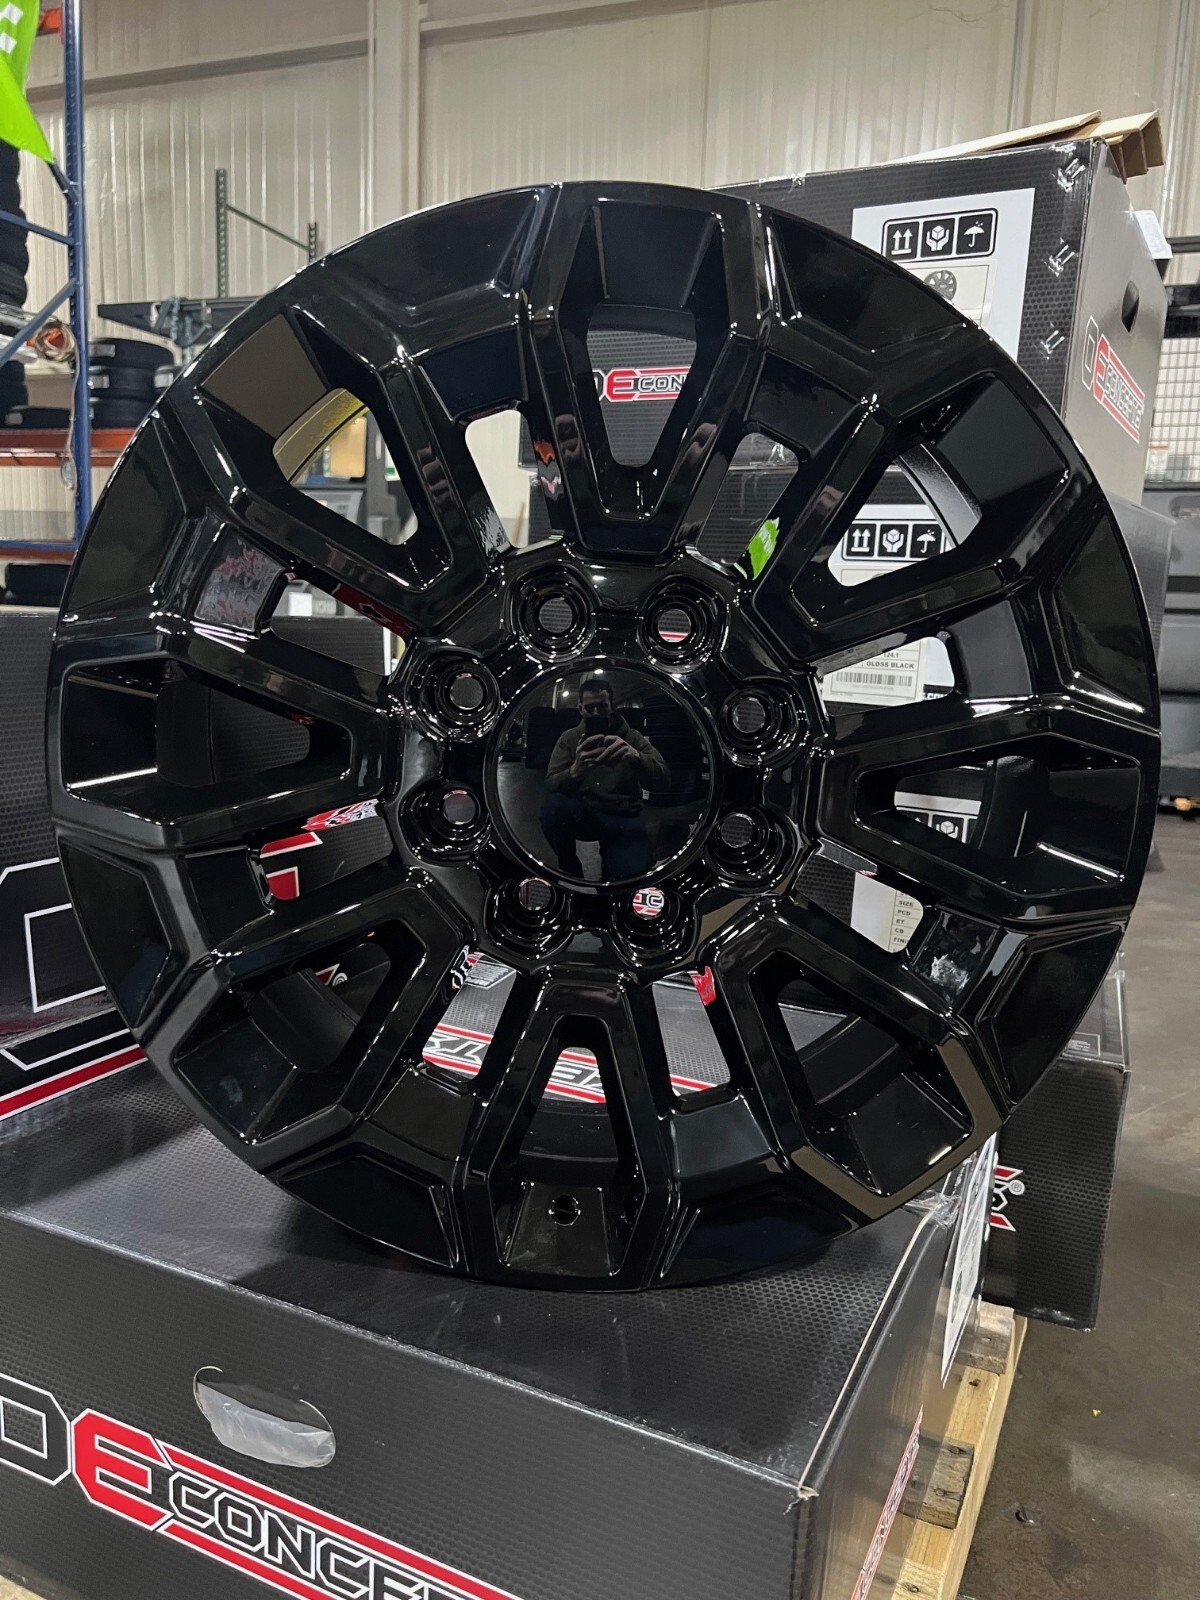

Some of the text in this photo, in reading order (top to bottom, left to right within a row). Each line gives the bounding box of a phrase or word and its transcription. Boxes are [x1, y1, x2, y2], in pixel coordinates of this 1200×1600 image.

[866, 660, 915, 670] GLOSS BLACK
[168, 1470, 465, 1600] CONCE
